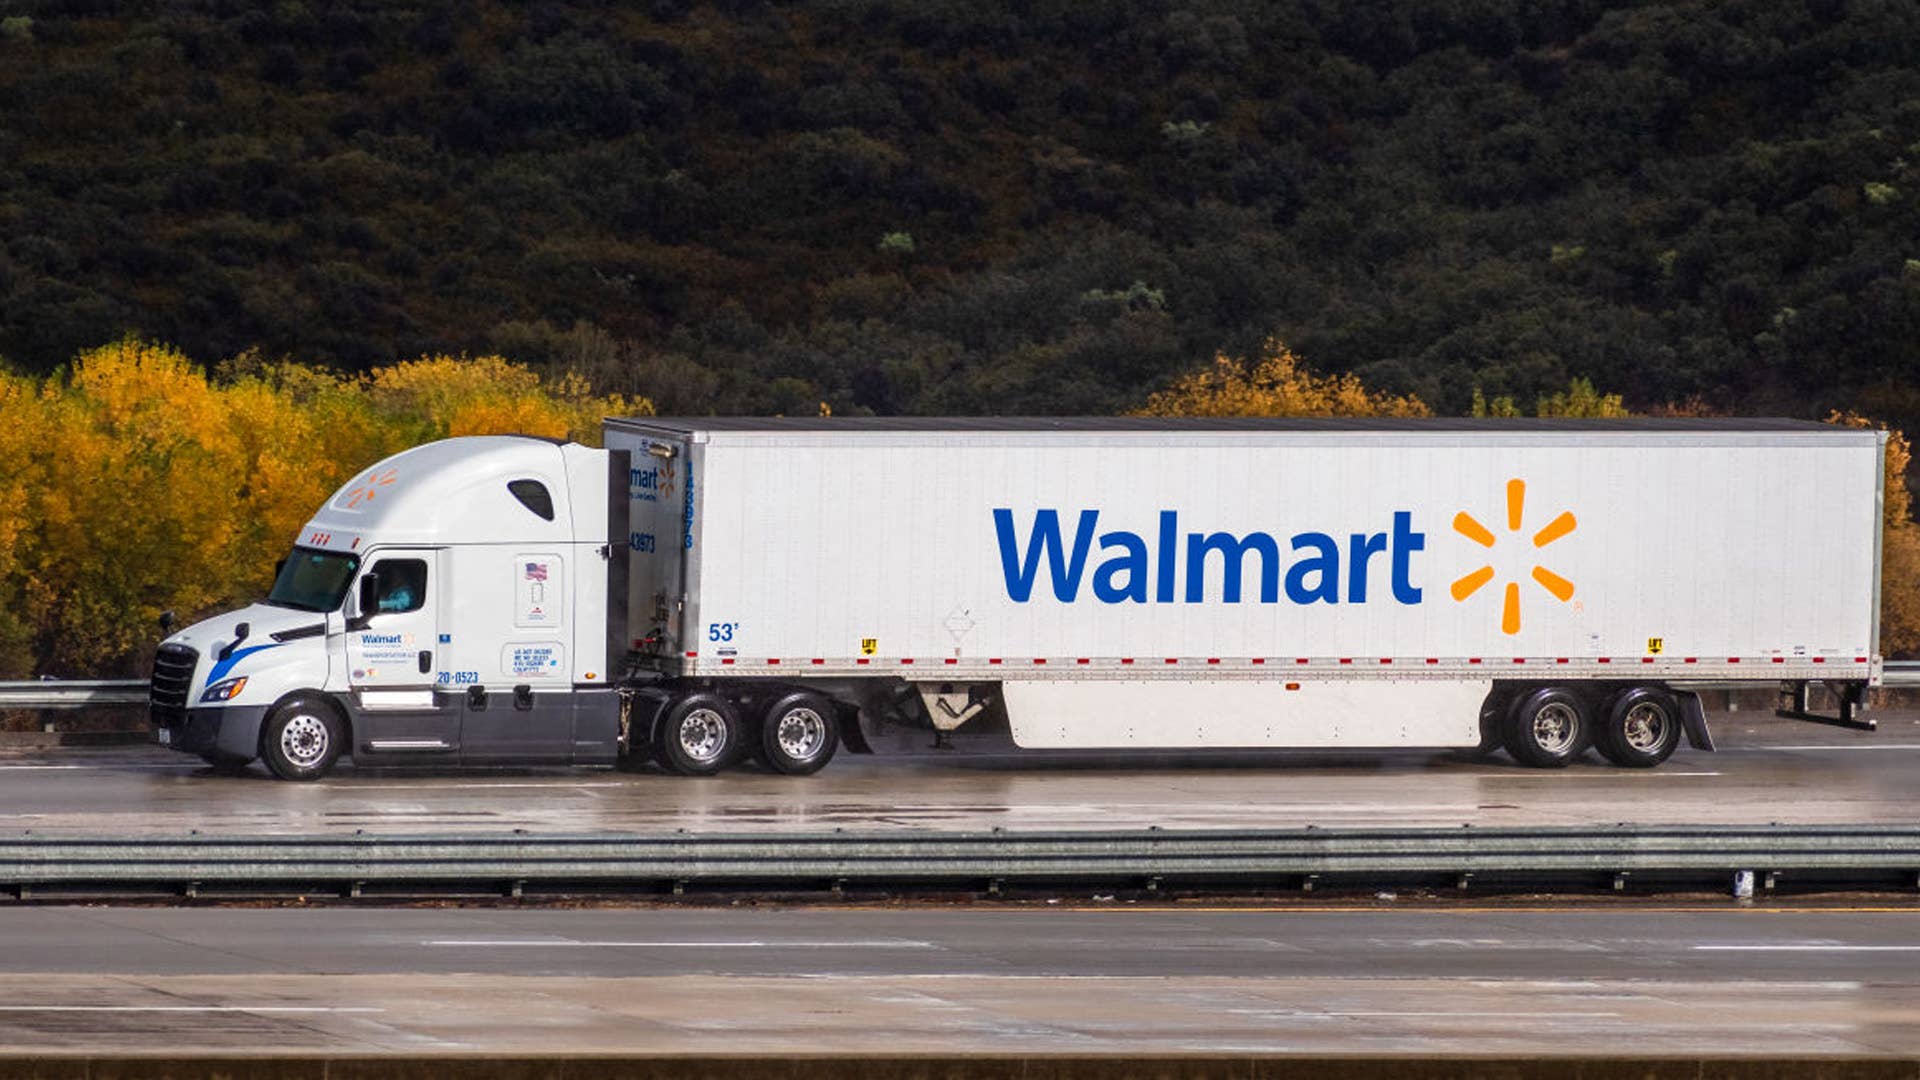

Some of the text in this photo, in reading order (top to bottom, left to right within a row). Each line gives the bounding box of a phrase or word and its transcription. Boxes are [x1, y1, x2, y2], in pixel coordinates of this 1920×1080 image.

[993, 508, 1425, 605] Walmart
[361, 634, 401, 643] Walmart
[709, 623, 739, 641] 53'
[1648, 638, 1662, 648] LIFT
[438, 671, 478, 684] 20-0523
